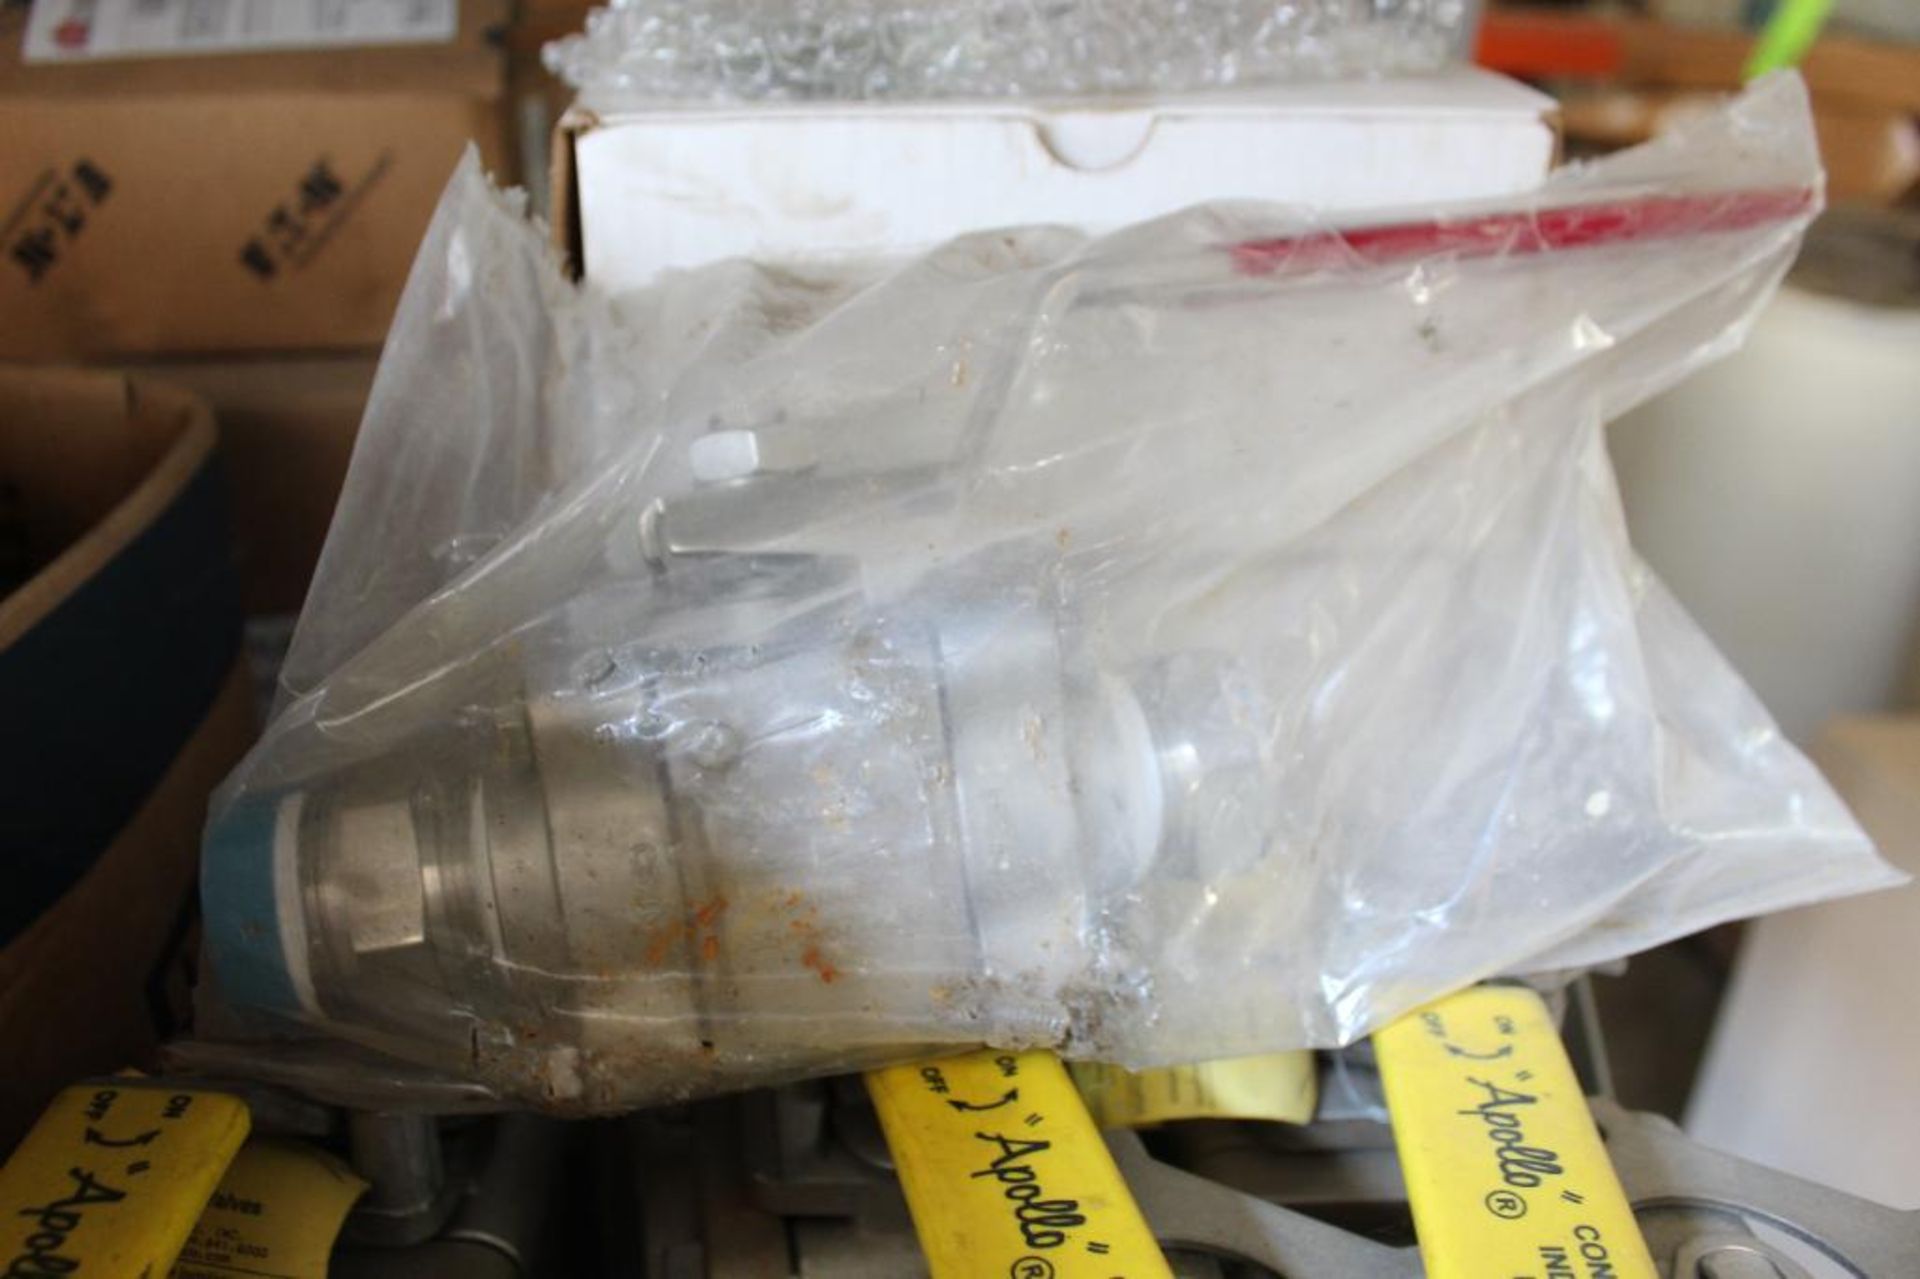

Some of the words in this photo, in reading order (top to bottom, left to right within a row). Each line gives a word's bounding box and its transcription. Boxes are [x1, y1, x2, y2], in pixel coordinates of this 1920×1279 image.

[995, 1055, 1018, 1077] ON
[920, 1066, 950, 1094] OFF
[162, 1094, 193, 1119] ON
